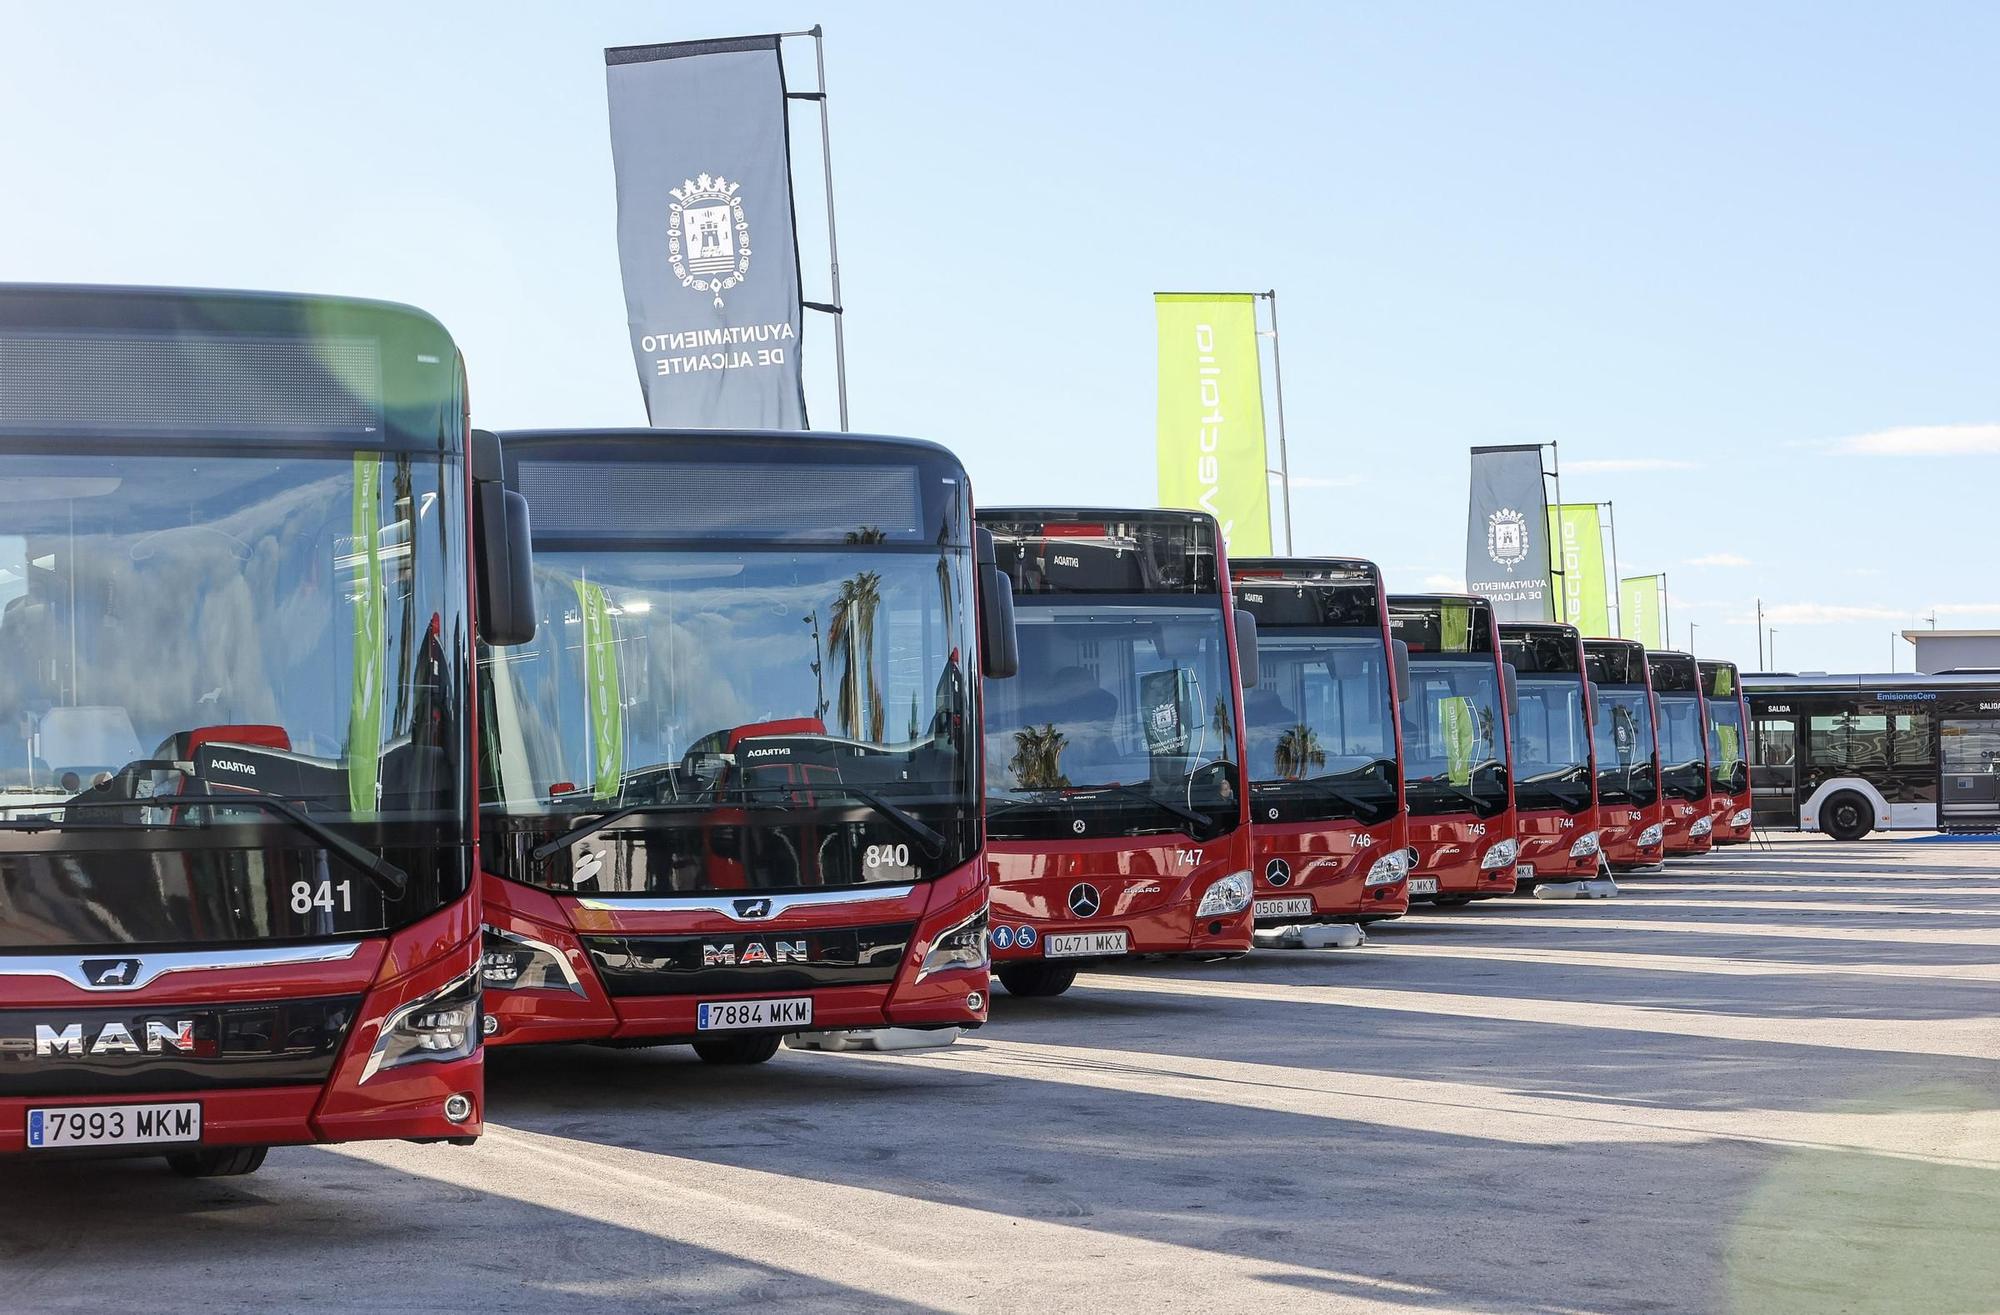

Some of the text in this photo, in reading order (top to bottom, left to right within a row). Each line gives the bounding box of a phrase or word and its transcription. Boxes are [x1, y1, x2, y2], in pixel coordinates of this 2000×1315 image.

[1877, 692, 1936, 700] EmisionesCero
[1768, 705, 1790, 713] SALIDA
[1628, 811, 1641, 821] 743
[1681, 806, 1693, 815] 742
[1467, 823, 1486, 835] 745
[1559, 818, 1574, 828] 744
[1349, 833, 1371, 847] 746
[866, 844, 909, 868] 840
[1176, 849, 1203, 866] 747
[1123, 886, 1161, 895] CITARO
[1417, 880, 1434, 890] MKX
[291, 880, 351, 914] 841
[1255, 900, 1309, 914] 0506 MKX
[1054, 935, 1123, 953] 0471 MKX
[703, 940, 808, 966] MAN
[713, 1002, 806, 1025] 7884 MKM
[36, 1021, 193, 1055] MAN
[50, 1109, 192, 1141] 7993 MKM
